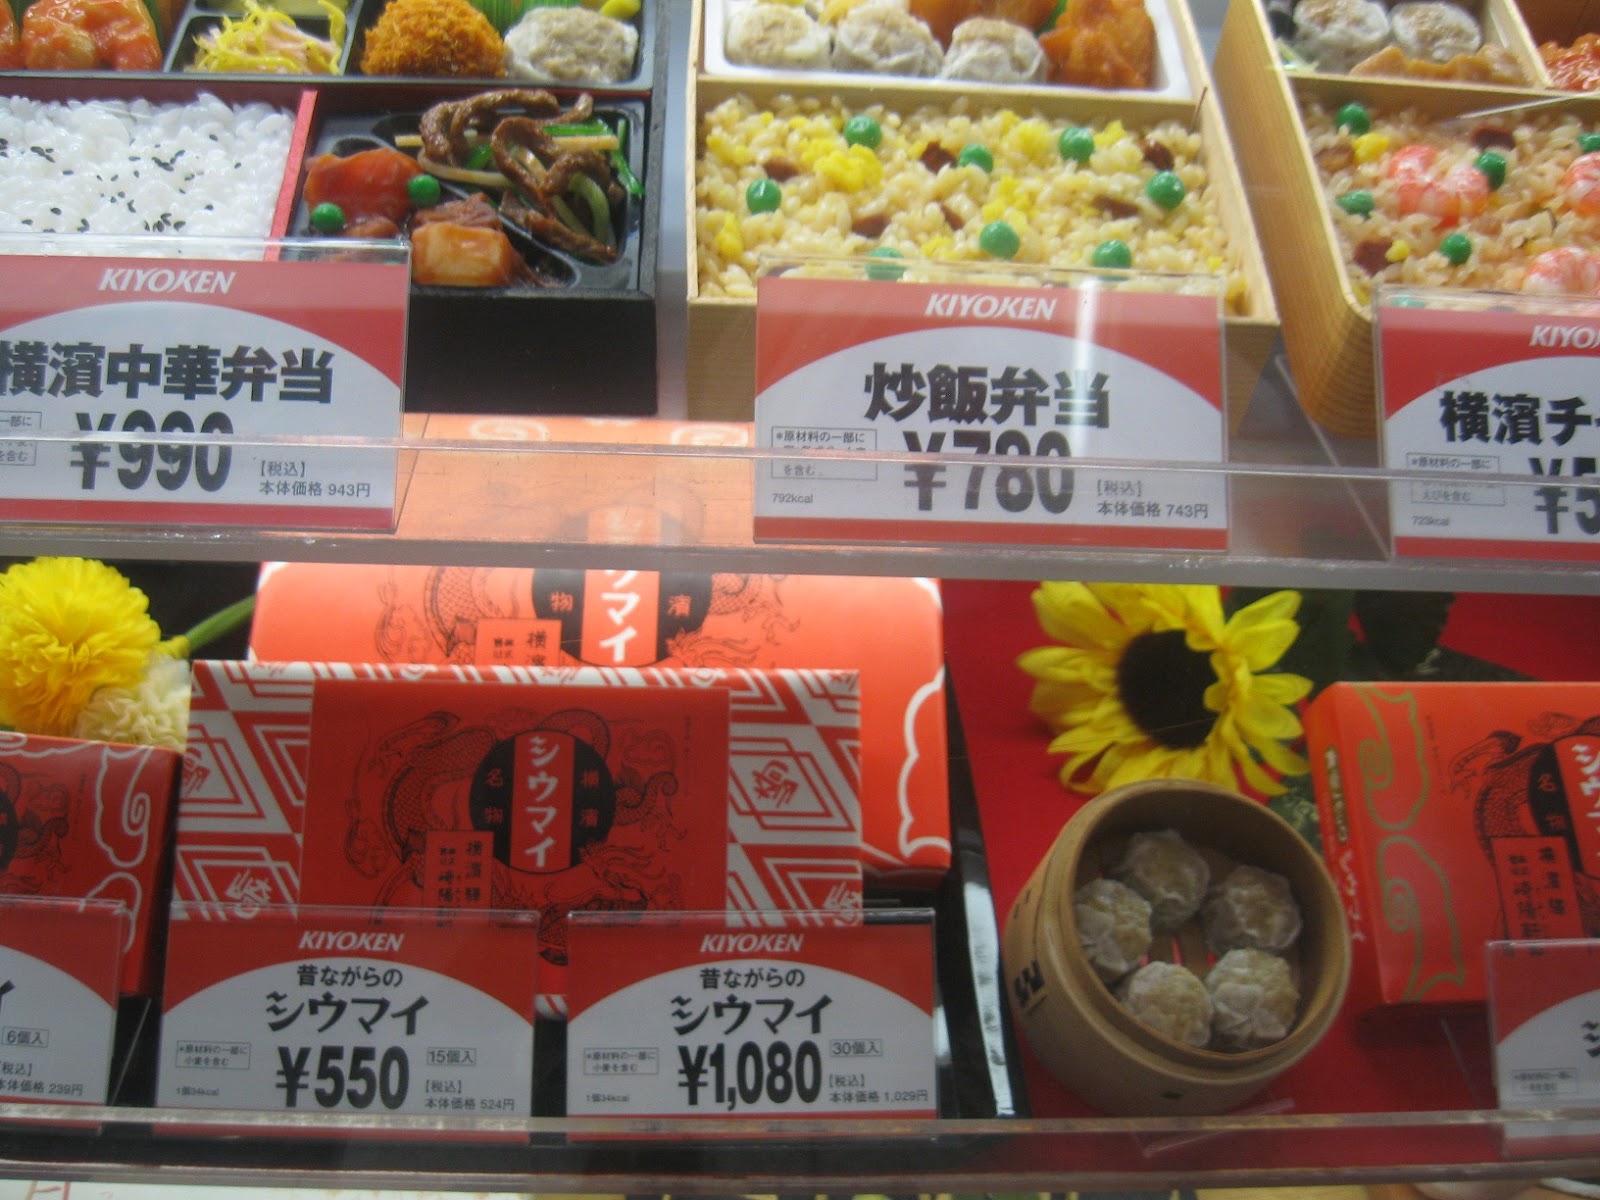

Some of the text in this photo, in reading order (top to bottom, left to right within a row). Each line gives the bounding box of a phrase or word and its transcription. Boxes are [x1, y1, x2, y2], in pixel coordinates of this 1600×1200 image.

[98, 268, 237, 294] KIYOKEN
[924, 292, 1057, 320] KIYOKEN
[1529, 324, 1600, 350] KIYO
[0, 340, 335, 403] 横濱中華弁当
[863, 361, 1110, 429] 炒飯弁当
[1439, 391, 1600, 446] 横濱チ
[70, 410, 234, 491] ¥990
[903, 430, 1075, 514] ¥780
[260, 481, 371, 498] 本体価格 943円
[772, 492, 814, 504] 792kcal
[1097, 500, 1209, 519] 本体価格 743円
[525, 736, 560, 868] シウマイ
[299, 931, 404, 952] KIYOKEN
[700, 933, 804, 953] KIYOKEN
[297, 964, 403, 988] 昔ながらの
[700, 967, 806, 990] 昔ながらの
[266, 991, 429, 1036] シウマイ
[671, 993, 833, 1036] シウマイ
[7, 1029, 43, 1044] 6個入
[0, 1061, 32, 1076] 税込】
[275, 1045, 410, 1110] ¥550
[677, 1040, 822, 1111] ¥1,080
